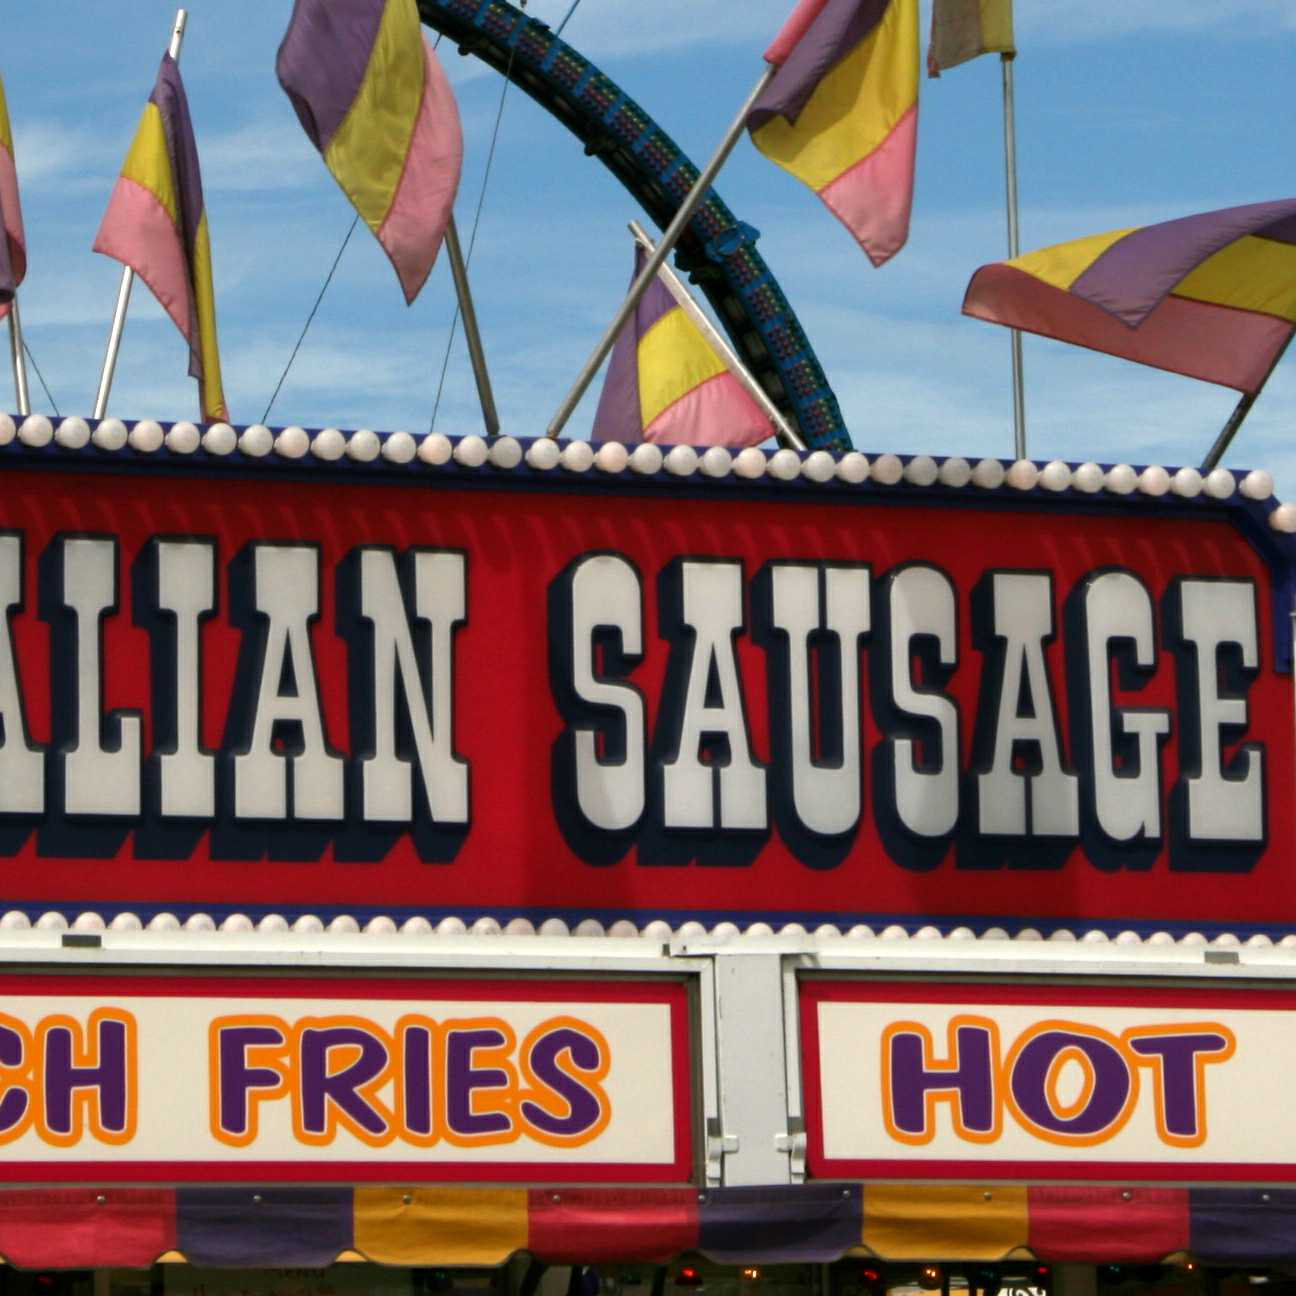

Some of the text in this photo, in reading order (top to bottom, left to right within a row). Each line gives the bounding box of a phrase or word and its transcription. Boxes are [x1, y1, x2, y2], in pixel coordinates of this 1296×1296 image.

[570, 553, 1264, 843] SAUSAGE
[209, 1014, 611, 1148] FRIES
[881, 1013, 1236, 1148] HOT
